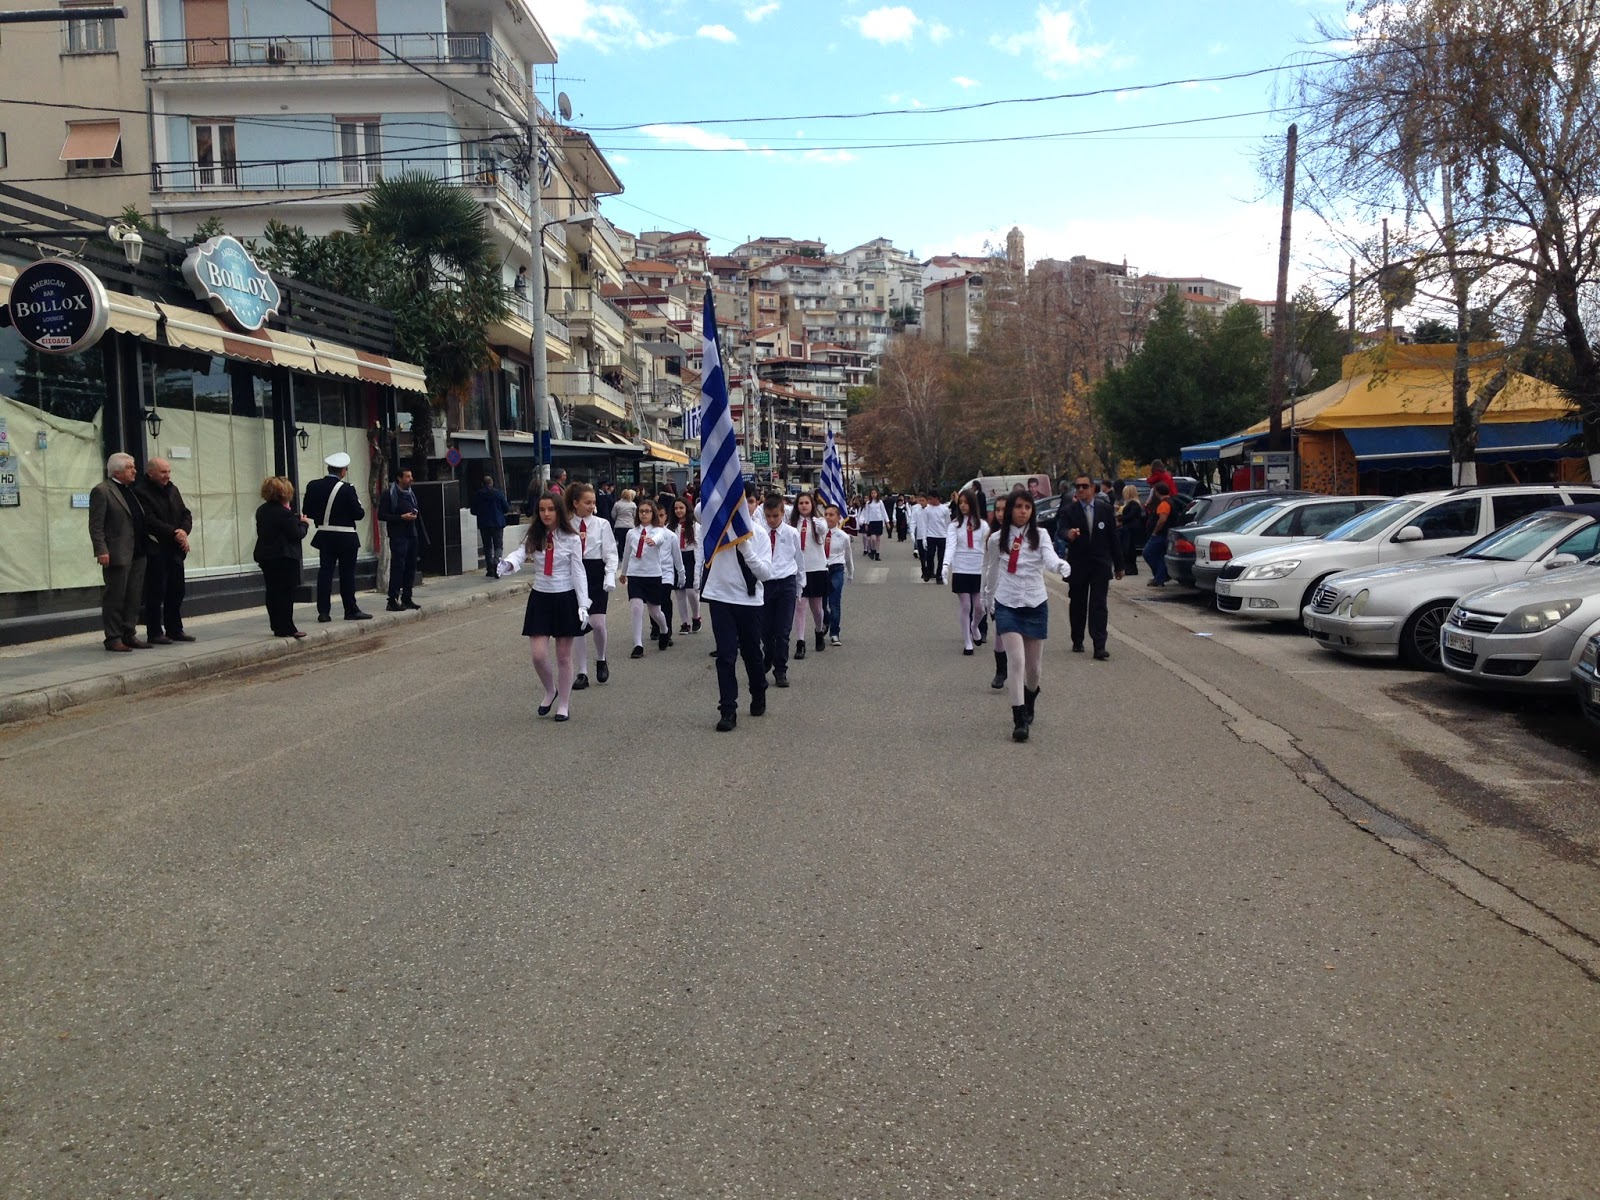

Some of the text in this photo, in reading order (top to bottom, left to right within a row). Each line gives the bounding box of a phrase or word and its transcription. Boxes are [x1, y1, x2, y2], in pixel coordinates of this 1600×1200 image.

[29, 279, 66, 293] AMERICAN
[206, 261, 271, 302] BOLLOX
[16, 294, 87, 318] BOLLOX
[42, 315, 64, 323] LOUNGE
[1, 473, 14, 484] HD
